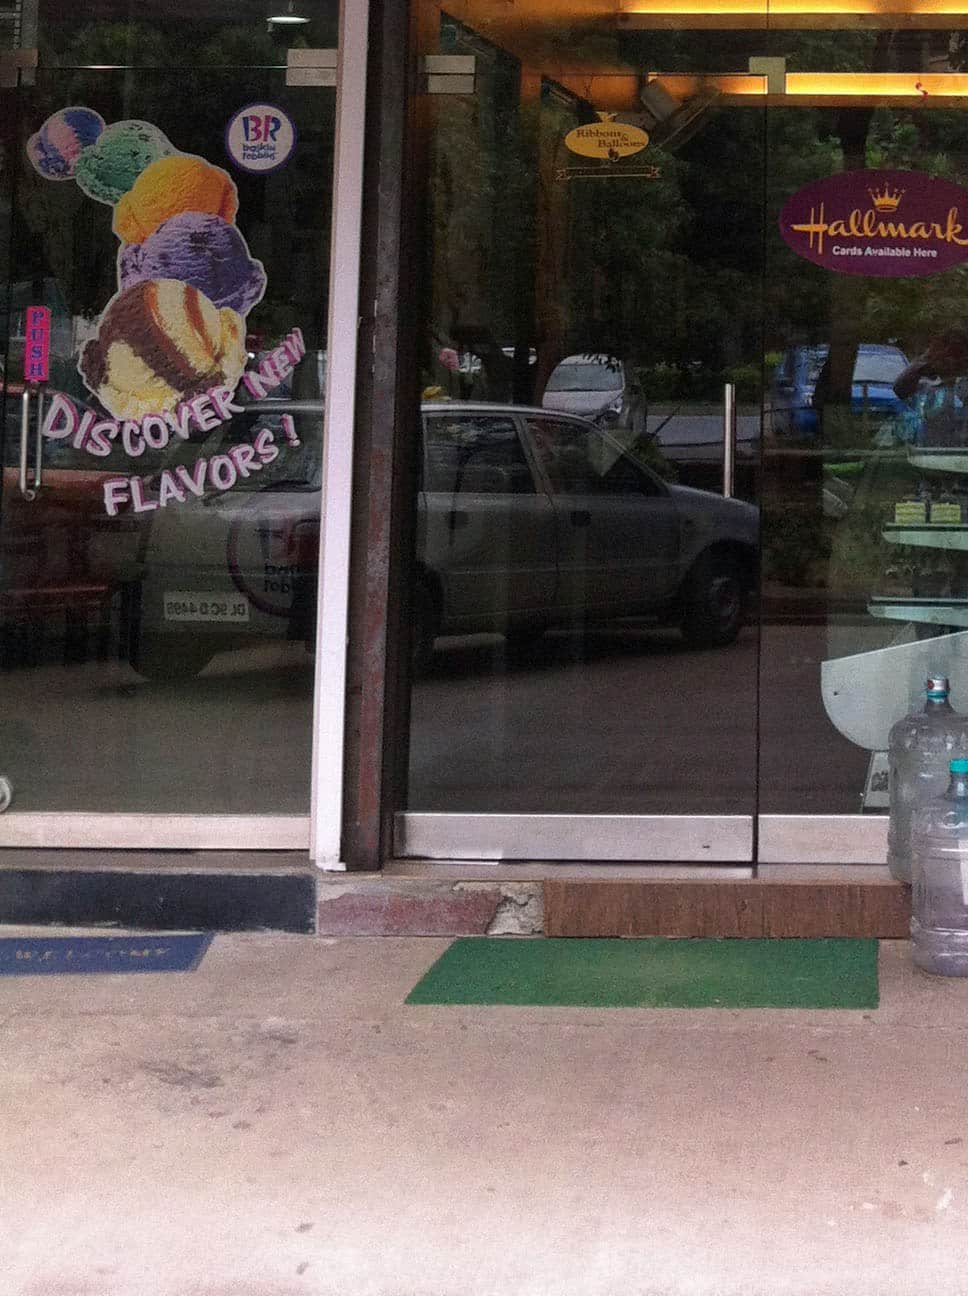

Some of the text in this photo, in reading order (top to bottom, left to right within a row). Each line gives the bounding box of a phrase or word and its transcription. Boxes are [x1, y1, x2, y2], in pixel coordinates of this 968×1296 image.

[242, 115, 281, 142] BR
[832, 245, 937, 258] Cards Available Here
[31, 311, 44, 377] PUSH
[41, 327, 306, 457] DISCOVER NEW
